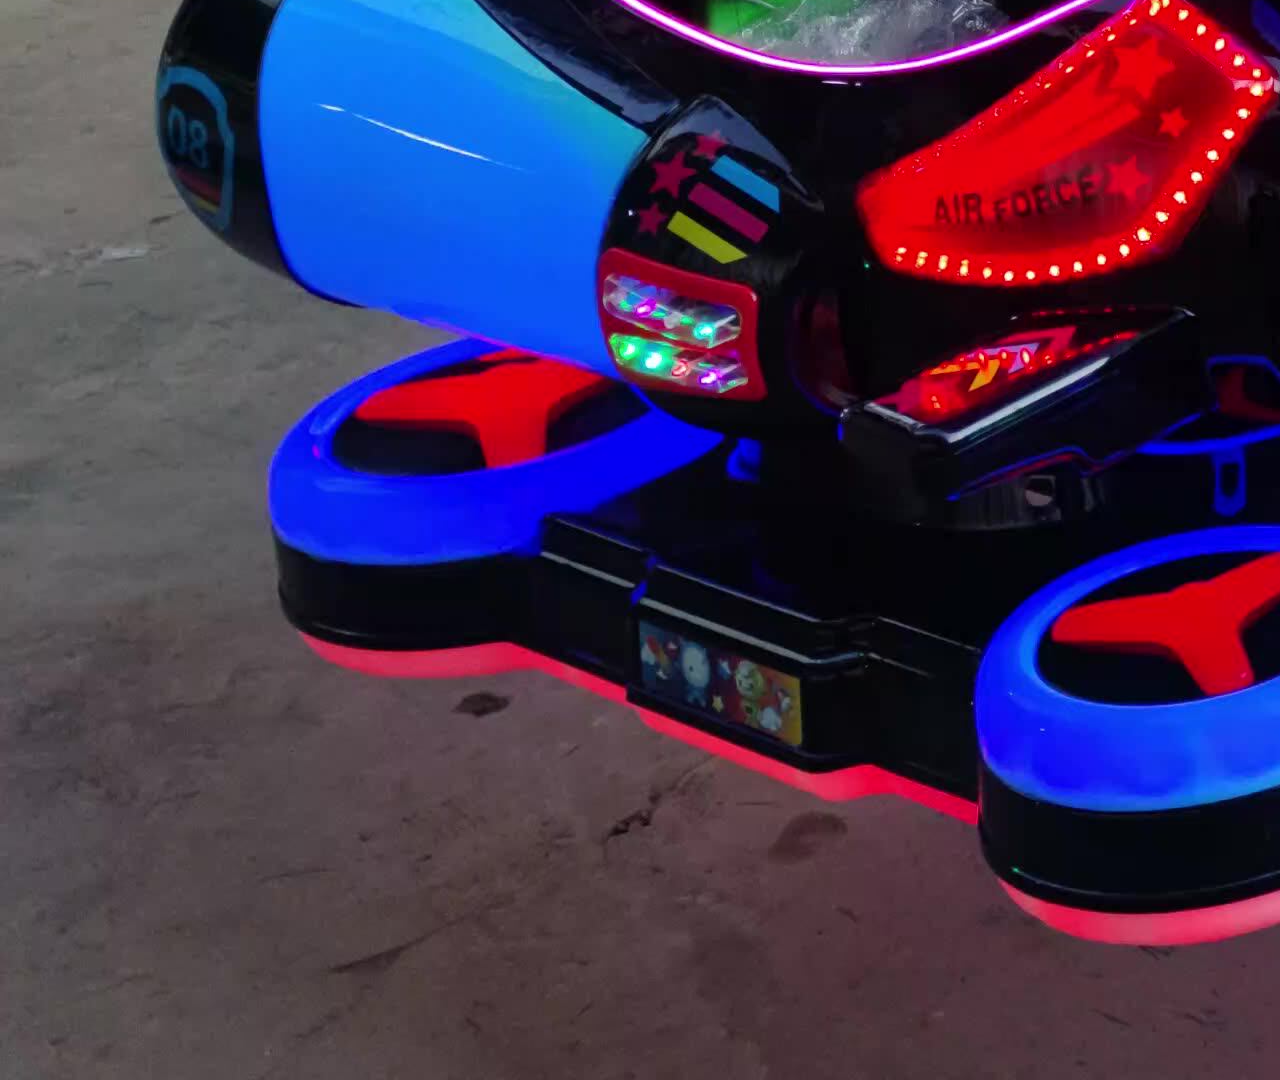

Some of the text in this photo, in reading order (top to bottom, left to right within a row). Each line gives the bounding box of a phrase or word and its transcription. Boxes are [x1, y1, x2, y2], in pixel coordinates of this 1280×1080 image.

[168, 104, 208, 168] 08
[934, 163, 1101, 224] AIR FORCE
